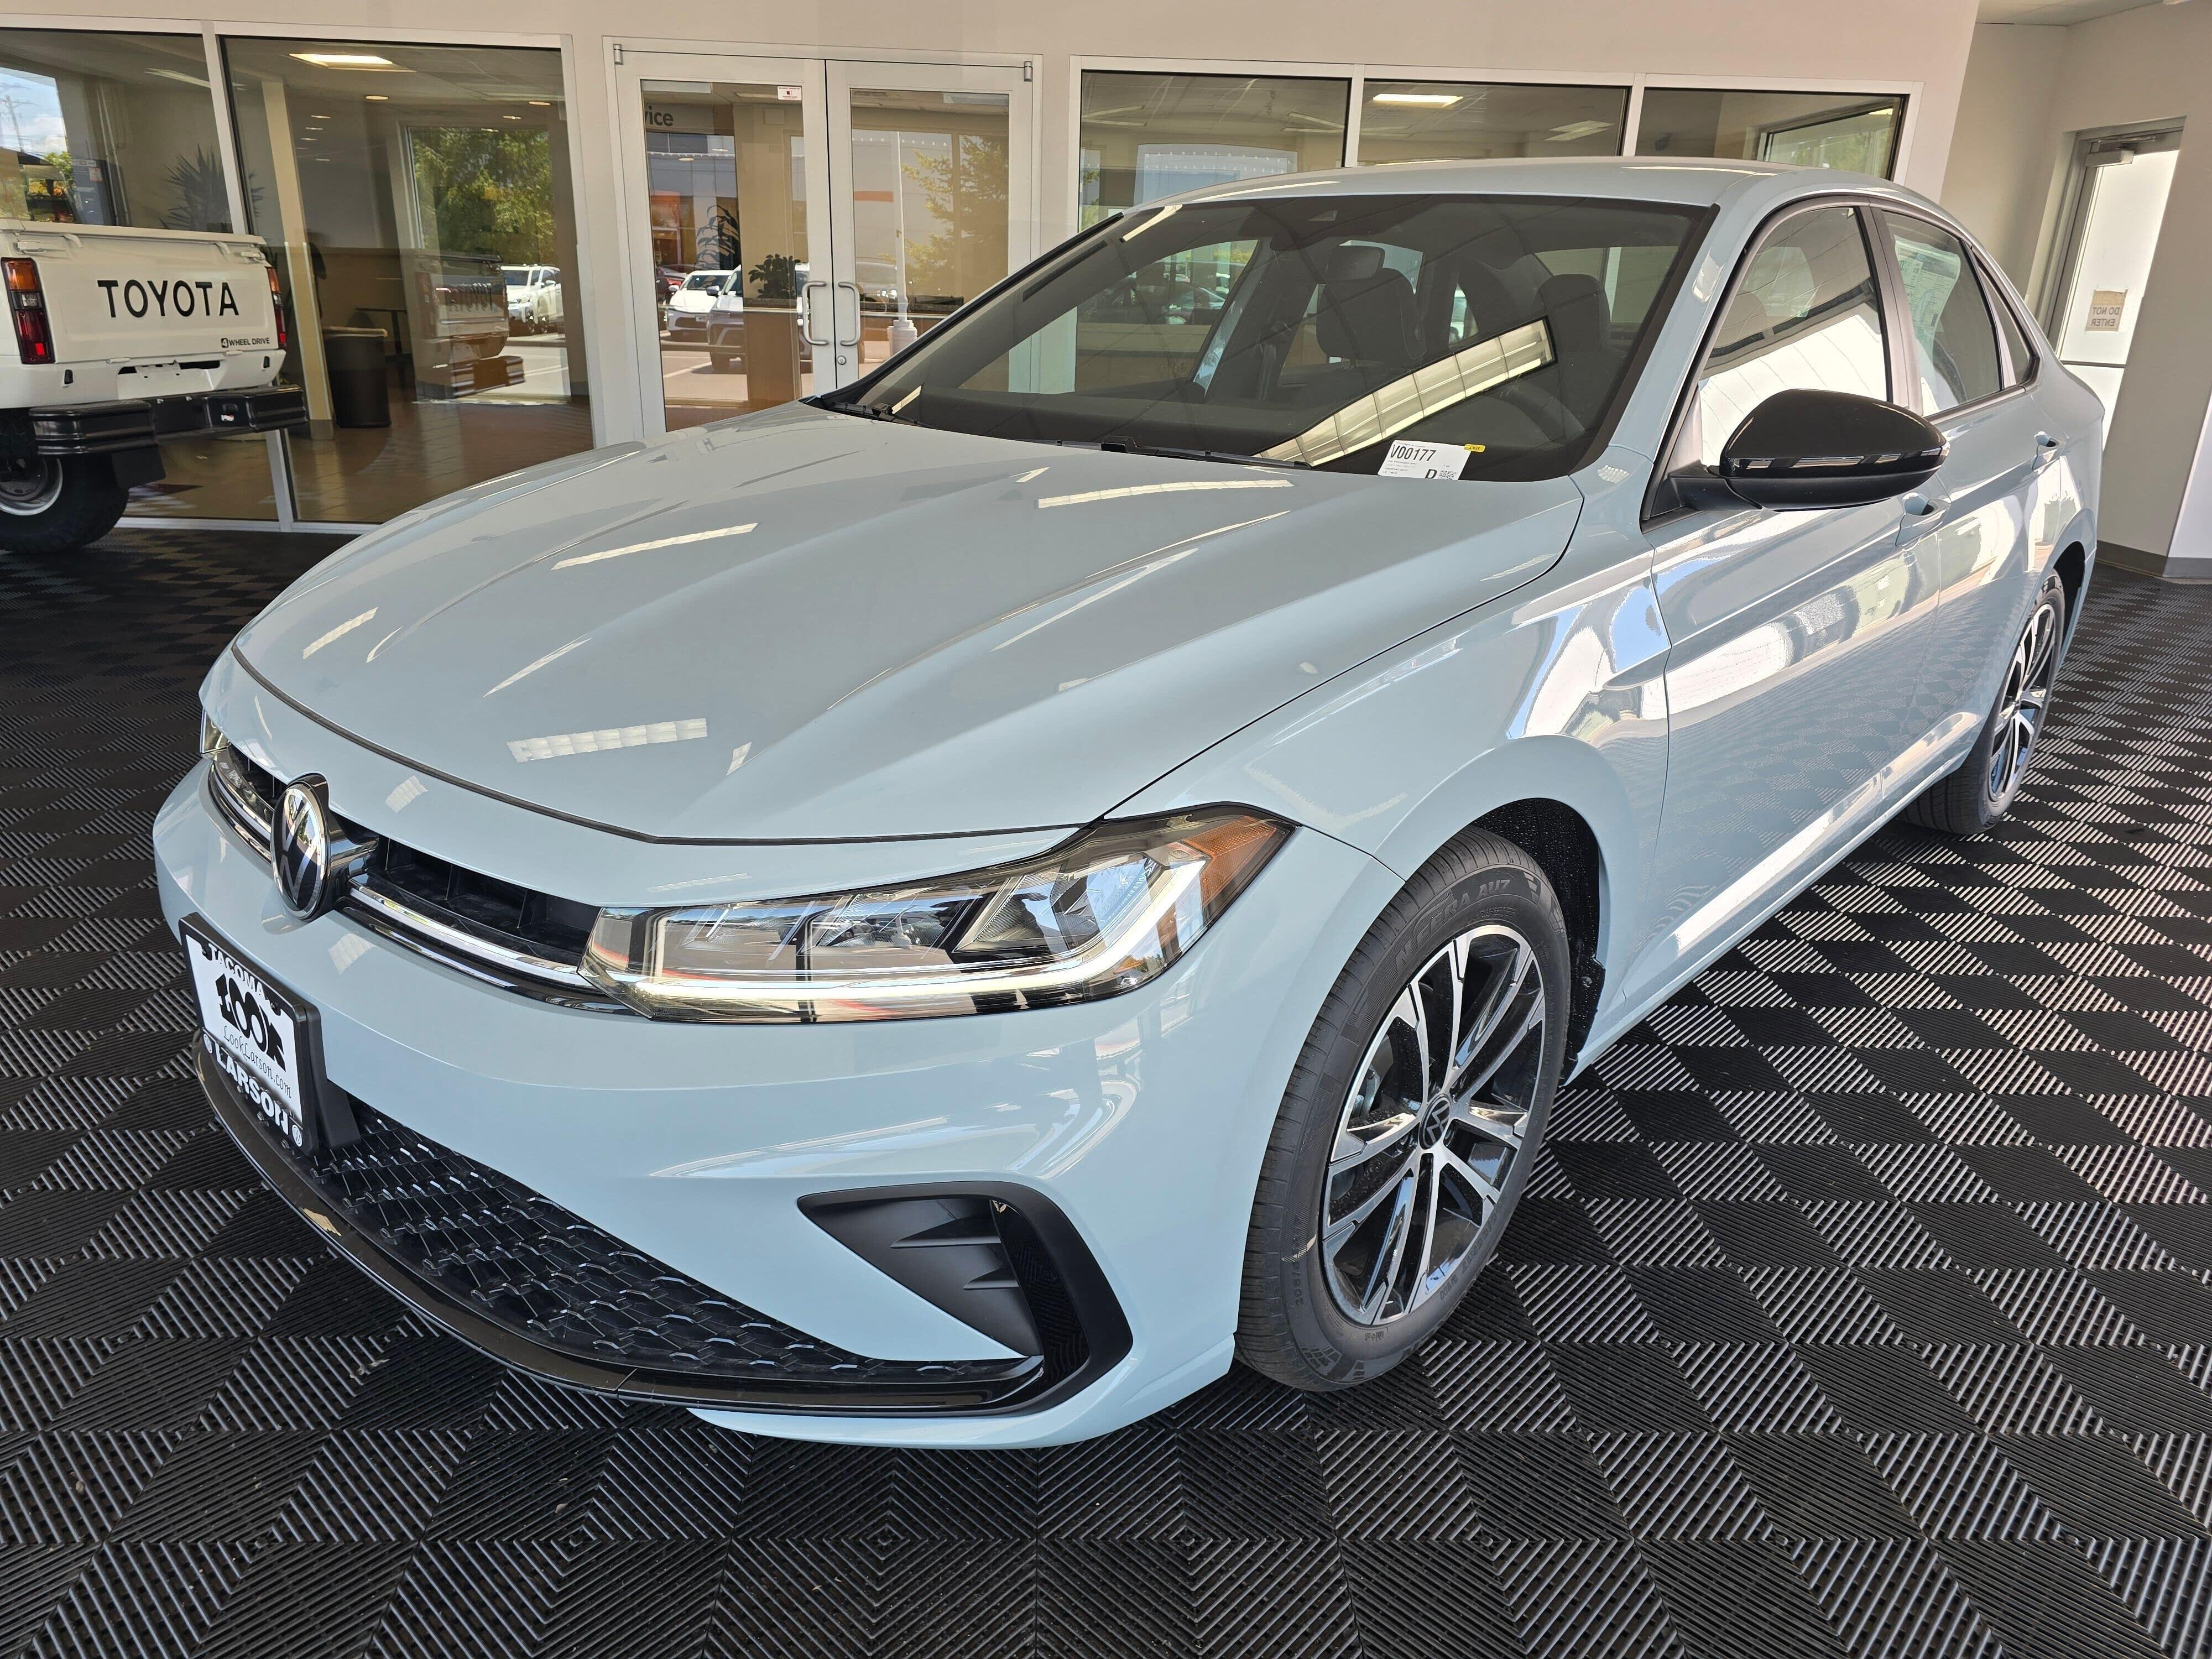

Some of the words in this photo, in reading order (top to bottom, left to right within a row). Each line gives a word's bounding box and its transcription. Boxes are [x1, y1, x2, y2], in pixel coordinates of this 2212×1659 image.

[97, 279, 239, 318] TOYOTA
[1390, 444, 1437, 462] V00177
[1425, 468, 1437, 479] D
[208, 943, 267, 1000] TACOMA
[224, 1026, 291, 1099] LookLarson.com
[215, 1041, 289, 1135] LARSON
